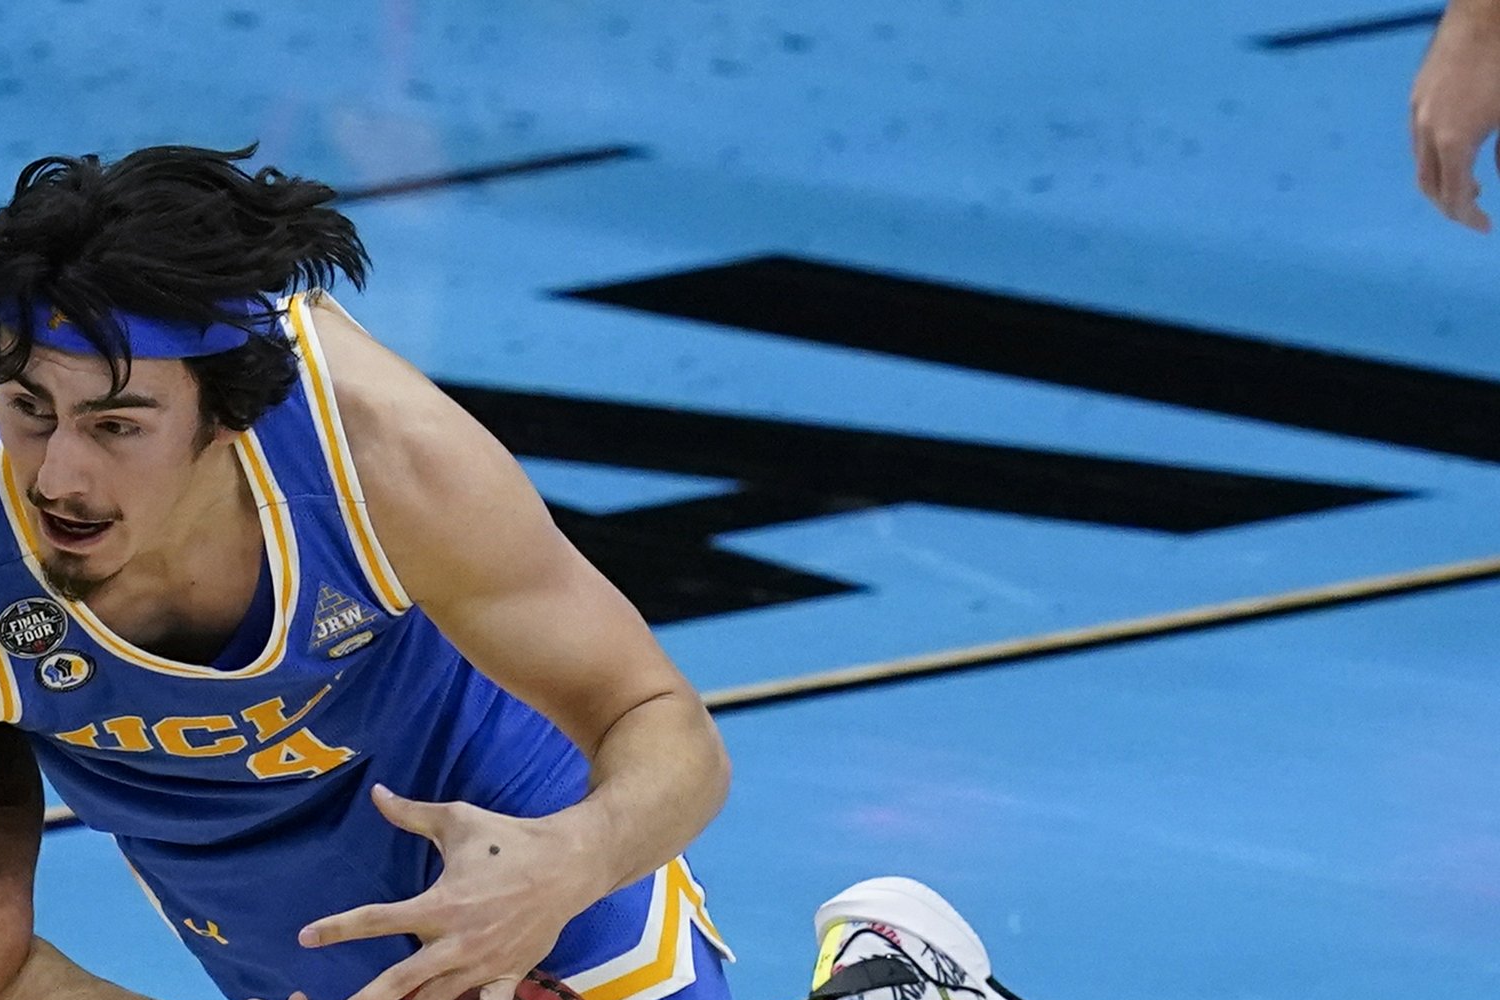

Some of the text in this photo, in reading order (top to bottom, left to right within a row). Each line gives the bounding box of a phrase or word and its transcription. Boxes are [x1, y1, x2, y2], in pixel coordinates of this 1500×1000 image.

[8, 610, 50, 633] FINAL
[14, 623, 55, 646] FOUR
[246, 727, 362, 780] 4
